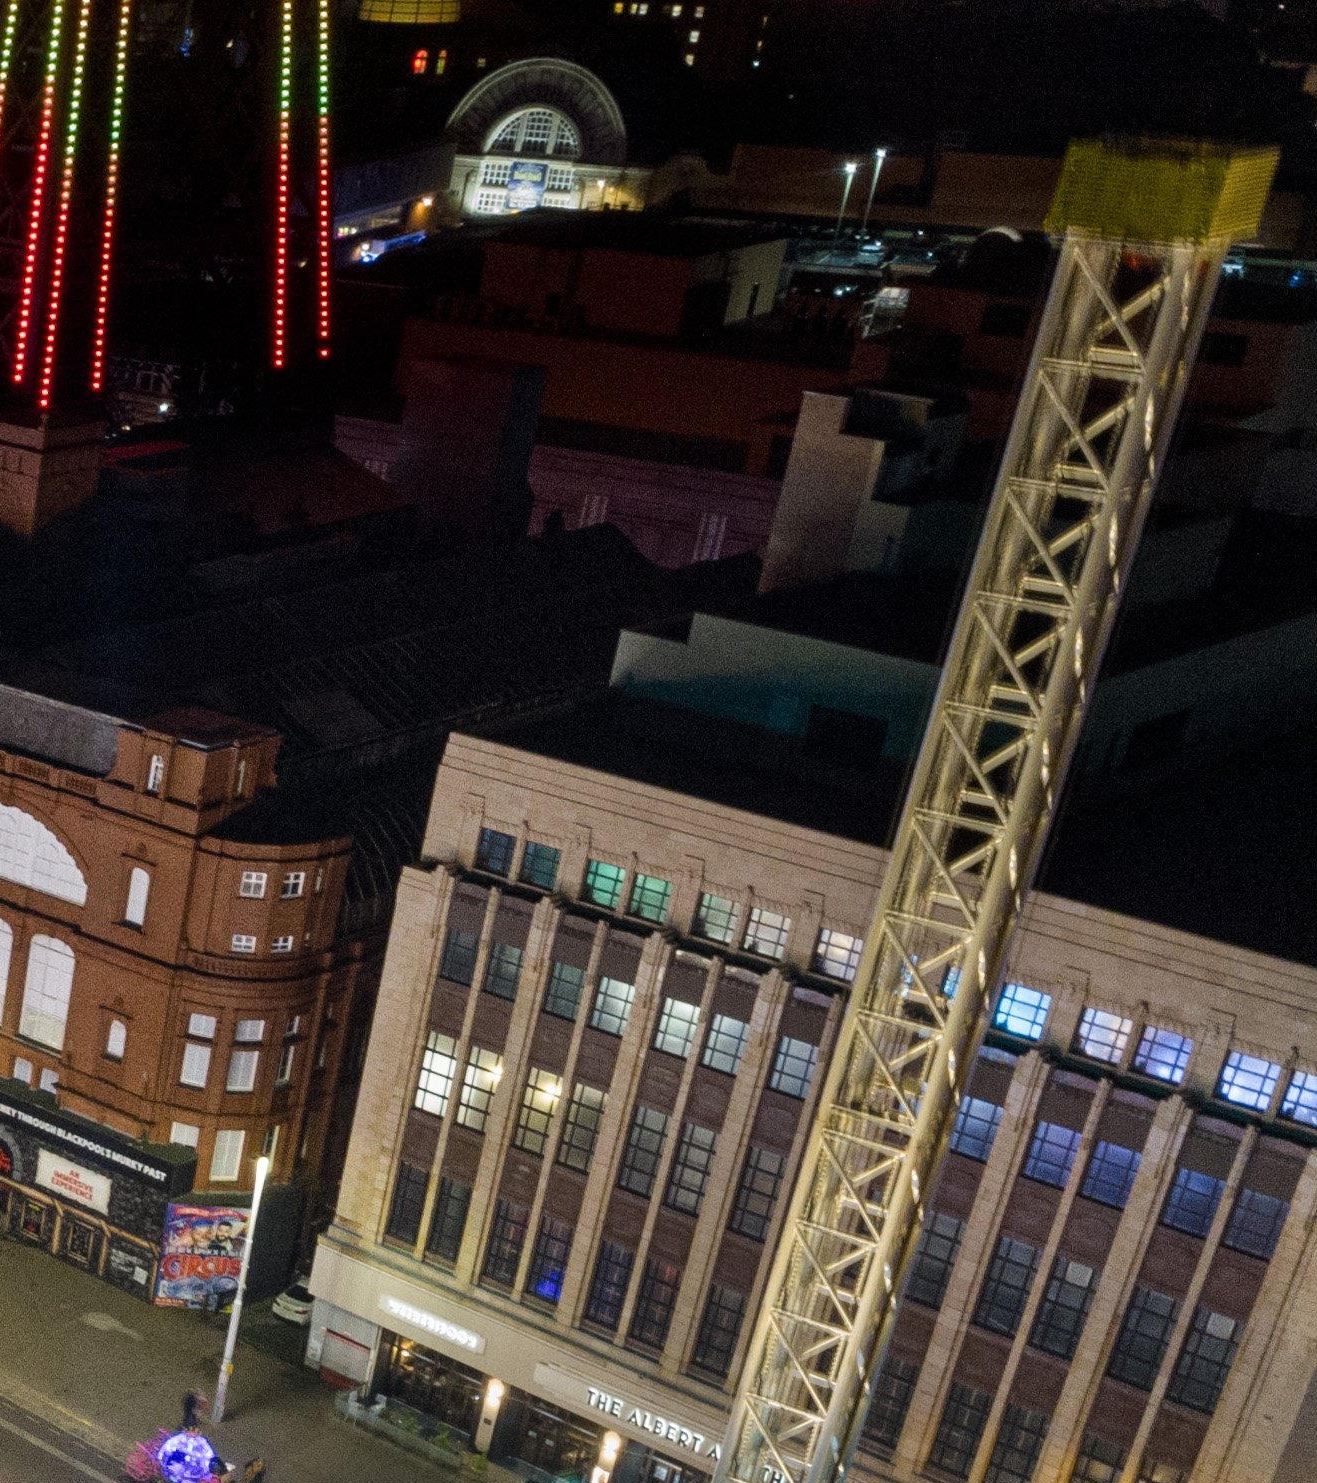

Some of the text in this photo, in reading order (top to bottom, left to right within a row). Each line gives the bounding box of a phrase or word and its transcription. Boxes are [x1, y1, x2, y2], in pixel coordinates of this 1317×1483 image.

[17, 1110, 56, 1135] THROUGH
[112, 1150, 144, 1172] MURKY
[143, 1163, 168, 1182] PAST
[51, 1176, 93, 1201] EXPERIENCE
[586, 1387, 623, 1417] THE
[627, 1407, 705, 1453] ALBERT
